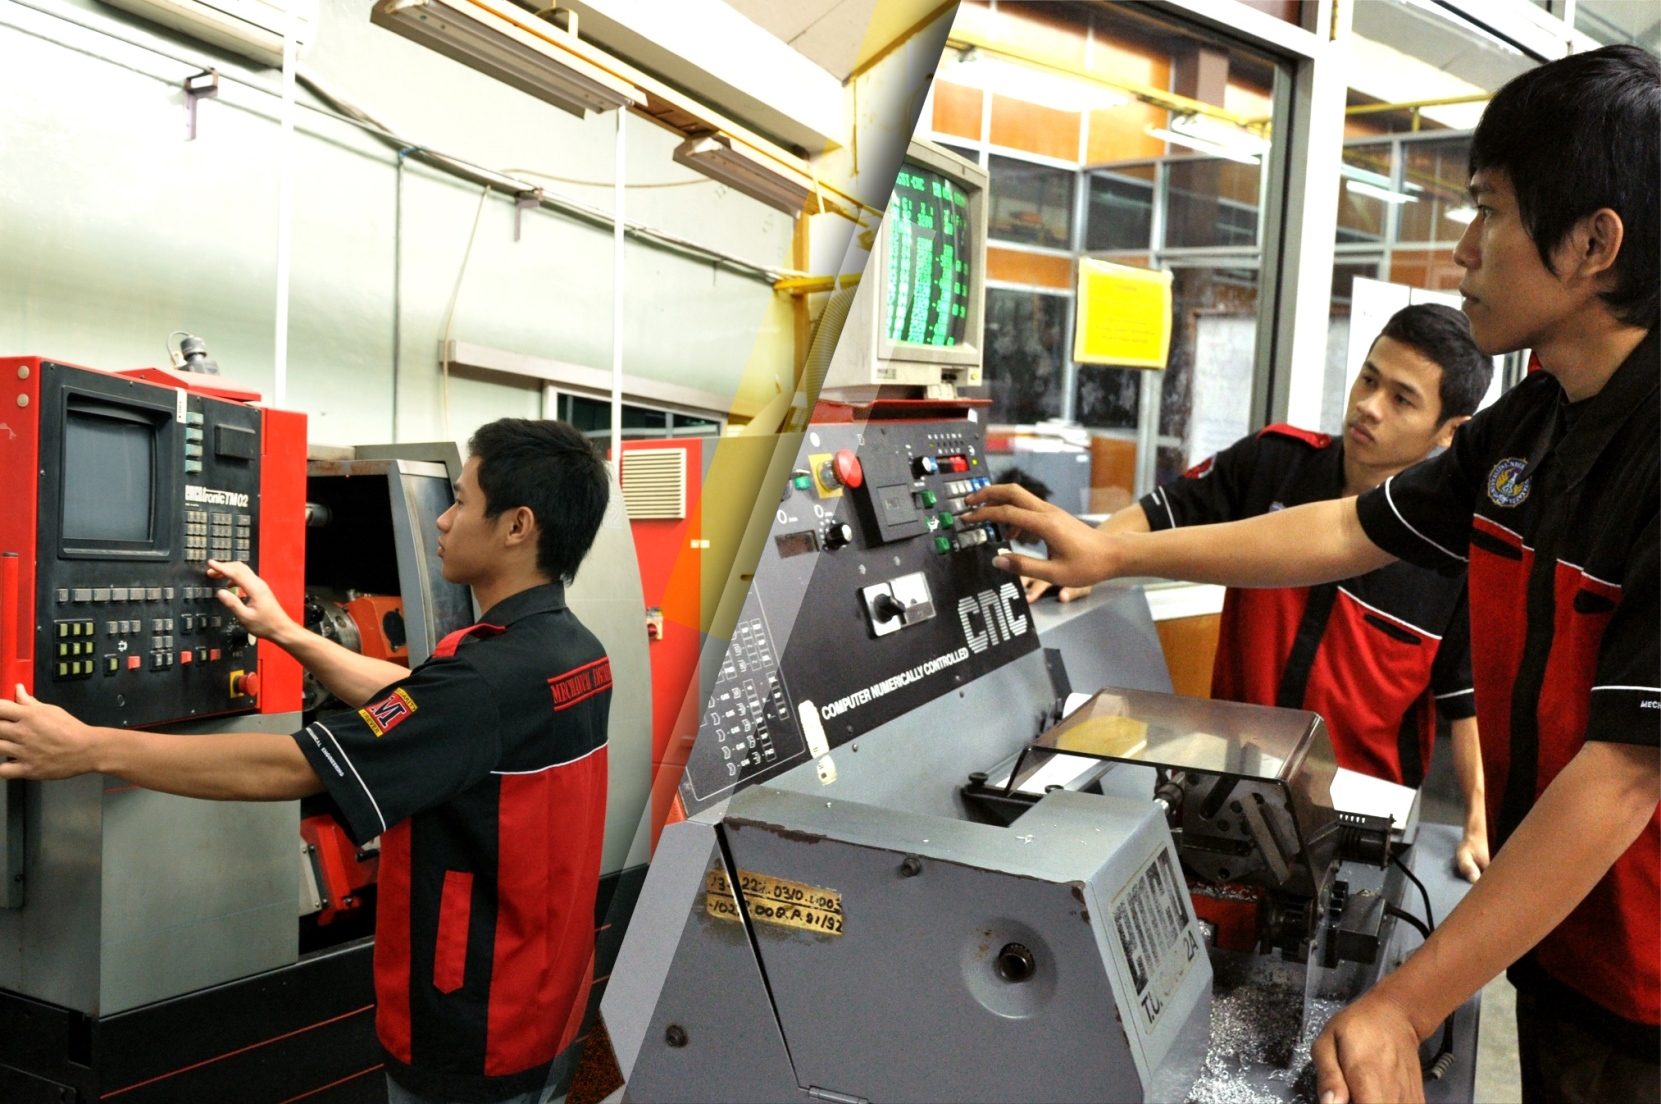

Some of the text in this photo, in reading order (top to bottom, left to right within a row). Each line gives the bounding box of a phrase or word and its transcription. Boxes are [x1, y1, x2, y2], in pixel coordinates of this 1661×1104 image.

[821, 688, 872, 720] COMPUTER
[870, 664, 925, 699] NUMERICALLY
[923, 647, 969, 676] CONTROLLED
[369, 695, 407, 729] M
